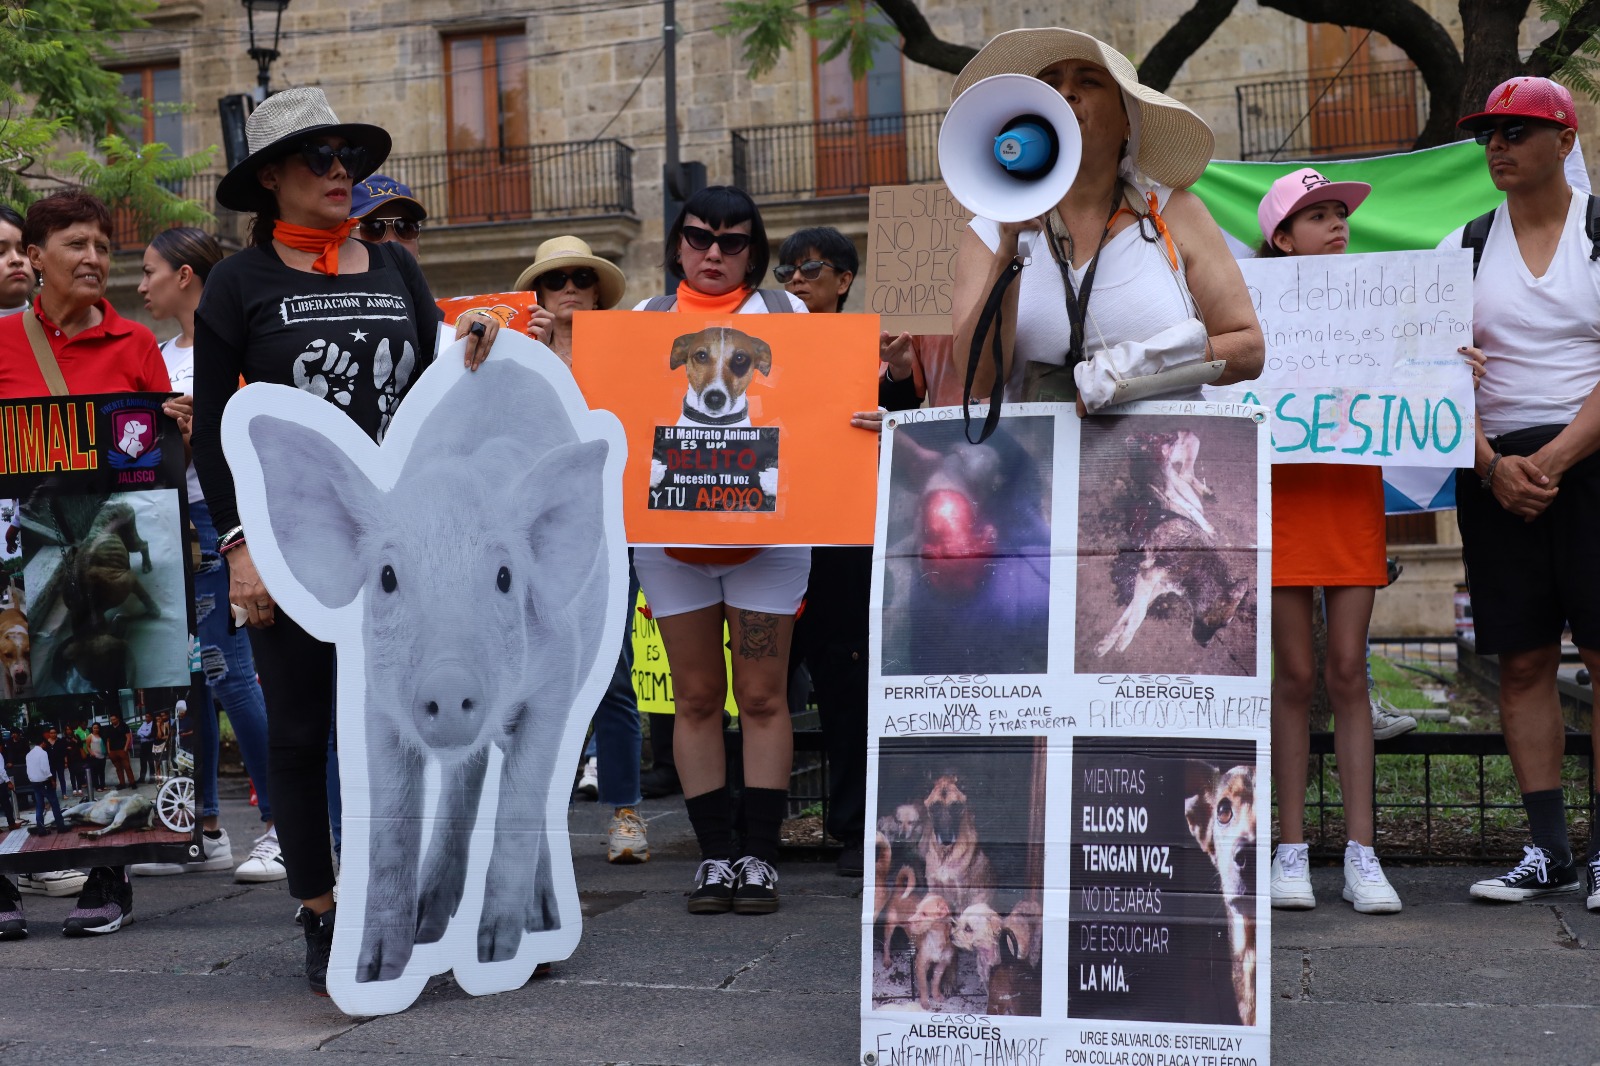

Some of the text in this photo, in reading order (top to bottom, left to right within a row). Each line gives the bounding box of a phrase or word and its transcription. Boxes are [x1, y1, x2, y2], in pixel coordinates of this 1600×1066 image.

[875, 190, 907, 218] EL
[876, 222, 914, 250] NO
[1279, 262, 1416, 313] debilidad
[1425, 263, 1456, 304] de
[291, 297, 361, 313] LIBERACIÓN
[1265, 350, 1381, 373] osotros.
[904, 410, 926, 424] NO
[665, 428, 760, 440] El Maltrato Animal
[681, 440, 697, 450] ES
[118, 470, 155, 484] JALISCO
[674, 473, 749, 485] Necesito TU voz
[651, 486, 763, 511] Y TU APOYO
[646, 644, 660, 661] ES
[924, 674, 988, 685] CASO
[1098, 675, 1194, 685] CASOS
[885, 685, 1042, 699] PERRITA DESOLLADA
[1115, 686, 1214, 700] ALBERGUES
[944, 703, 978, 716] VIVA
[885, 706, 1052, 734] ASESINADOS EN CALLE
[989, 716, 1076, 734] Y TRAS PUERTA
[1084, 769, 1146, 794] MIENTRAS
[1083, 806, 1148, 833] ELLOS NO
[1083, 845, 1173, 878] TENGAN VOZ,
[1081, 882, 1162, 914] NO DEJARÁS
[1081, 925, 1169, 953] DE ESCUCHAR
[1080, 958, 1129, 992] LA MÍA.
[930, 1014, 992, 1025] CASOS
[909, 1024, 1001, 1041] ALBERGUES
[1080, 1031, 1243, 1051] URGE SALVARLOS: ESTERILIZA Y
[1066, 1050, 1086, 1063] PON
[1089, 1051, 1129, 1066] COLLAR
[1132, 1053, 1154, 1066] CON
[1157, 1054, 1190, 1066] PLACA
